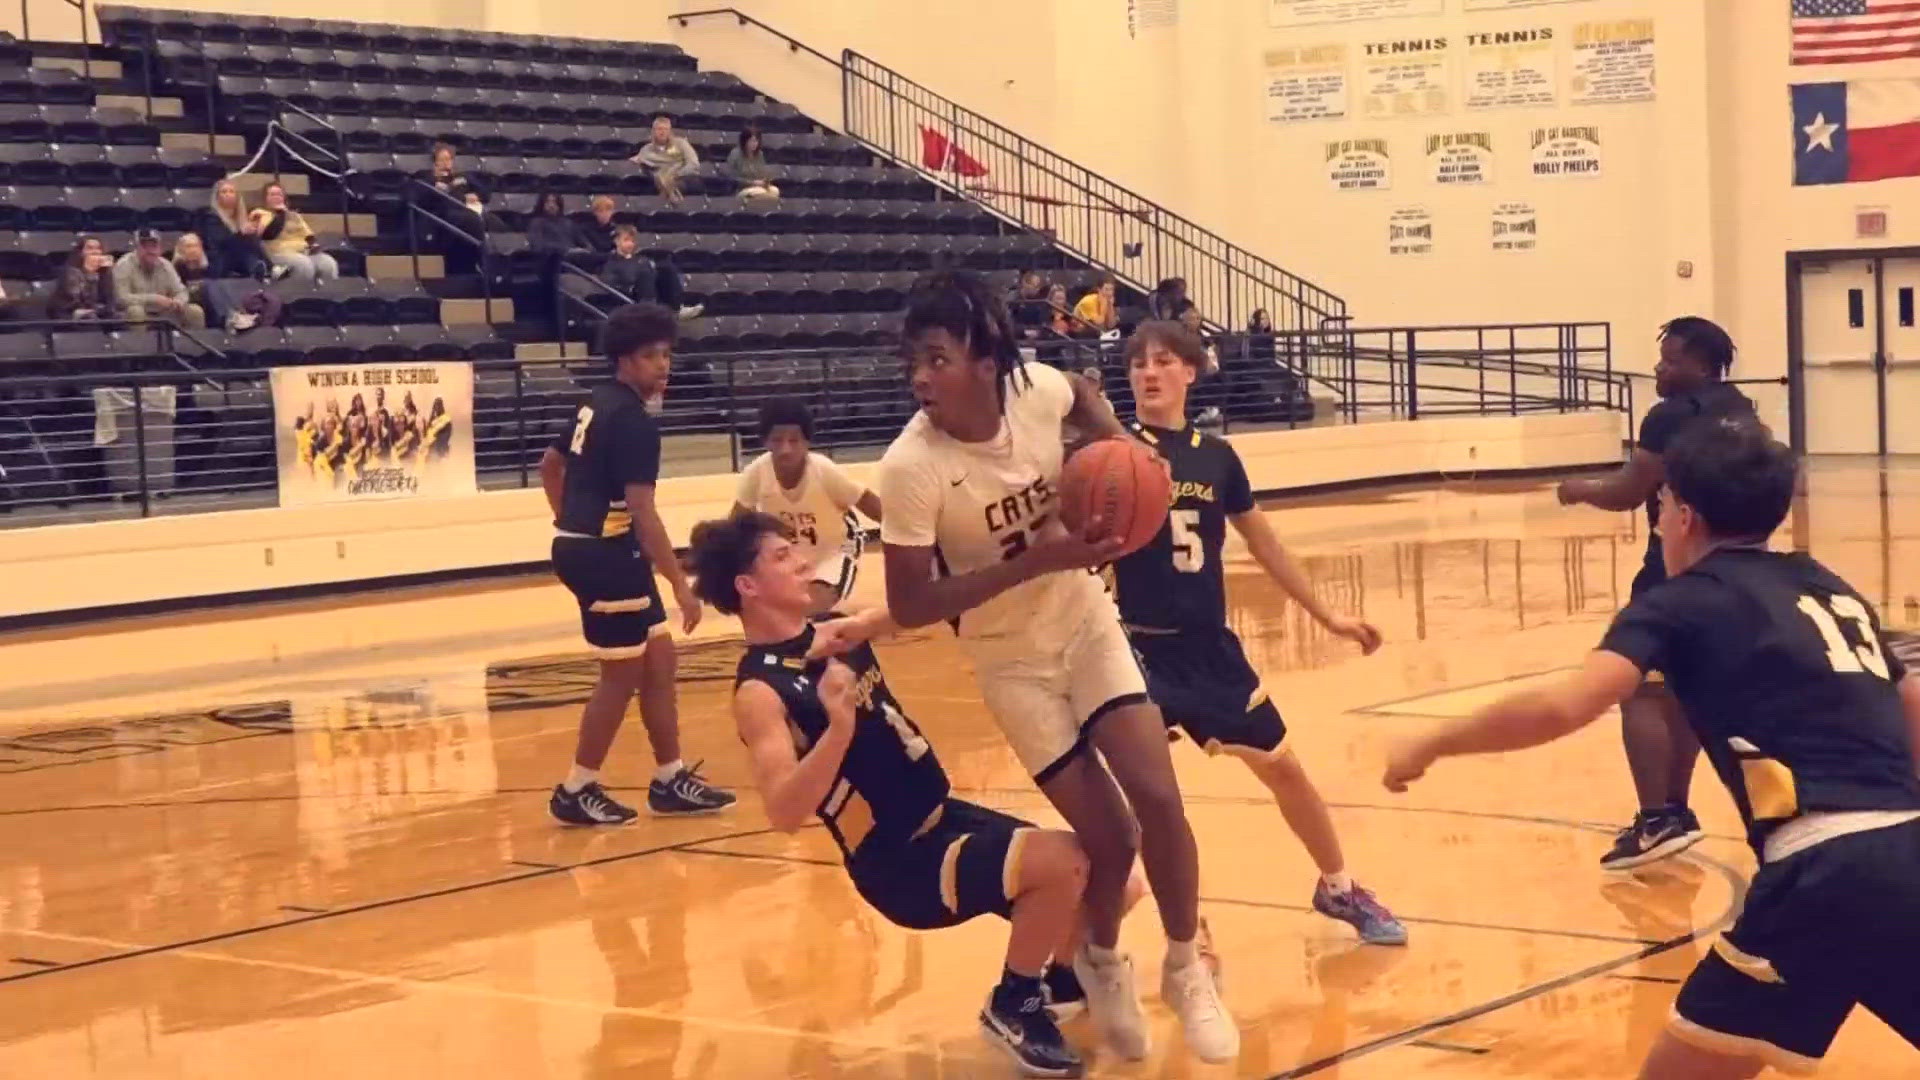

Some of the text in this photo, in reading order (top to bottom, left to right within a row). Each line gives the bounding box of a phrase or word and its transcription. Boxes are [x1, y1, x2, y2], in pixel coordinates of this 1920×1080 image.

[1464, 27, 1553, 46] TENNIS
[1363, 37, 1447, 56] TENNIS
[1547, 127, 1559, 141] CAT
[1533, 159, 1599, 175] HOLLY PHELPS
[363, 368, 392, 386] HIGH
[395, 368, 440, 385] SCHOOL
[984, 474, 1051, 535] CATS
[1169, 509, 1205, 573] 5
[1796, 592, 1890, 681] 13
